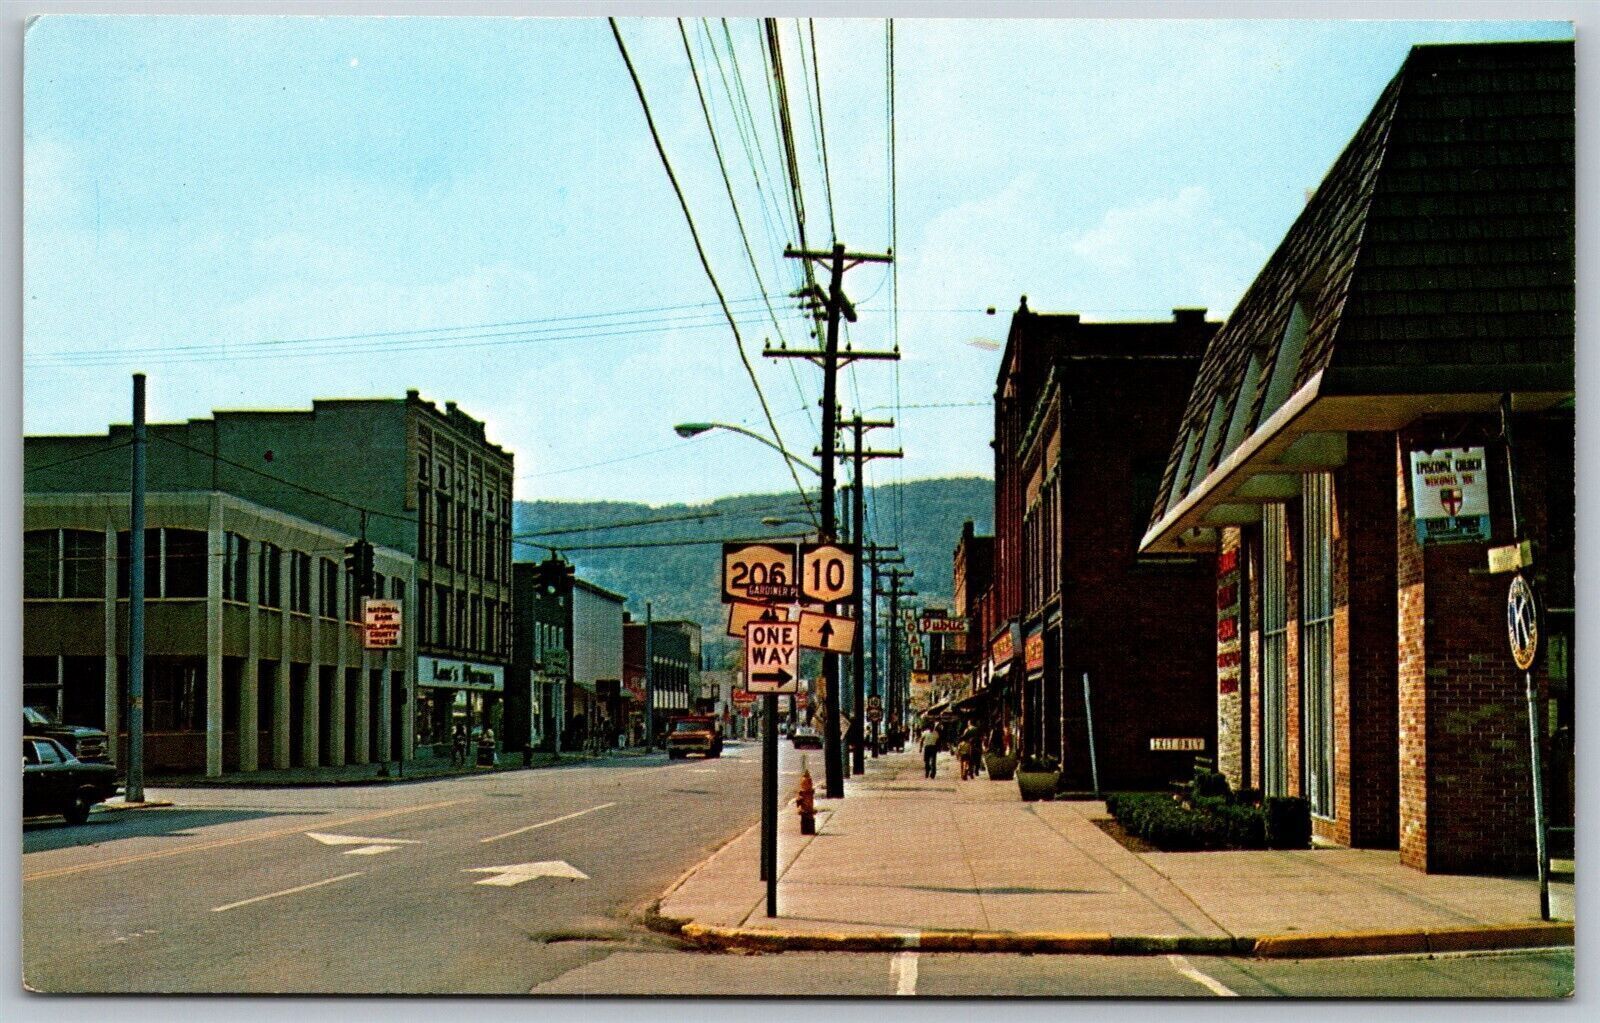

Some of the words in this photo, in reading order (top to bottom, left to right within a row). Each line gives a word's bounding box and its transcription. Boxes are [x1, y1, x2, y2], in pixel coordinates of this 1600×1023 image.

[731, 561, 786, 589] 206
[812, 558, 845, 592] 10
[749, 585, 788, 596] GARDINER
[790, 587, 799, 597] PL
[922, 618, 966, 633] Public
[753, 627, 793, 645] ONE
[753, 648, 794, 665] WAY
